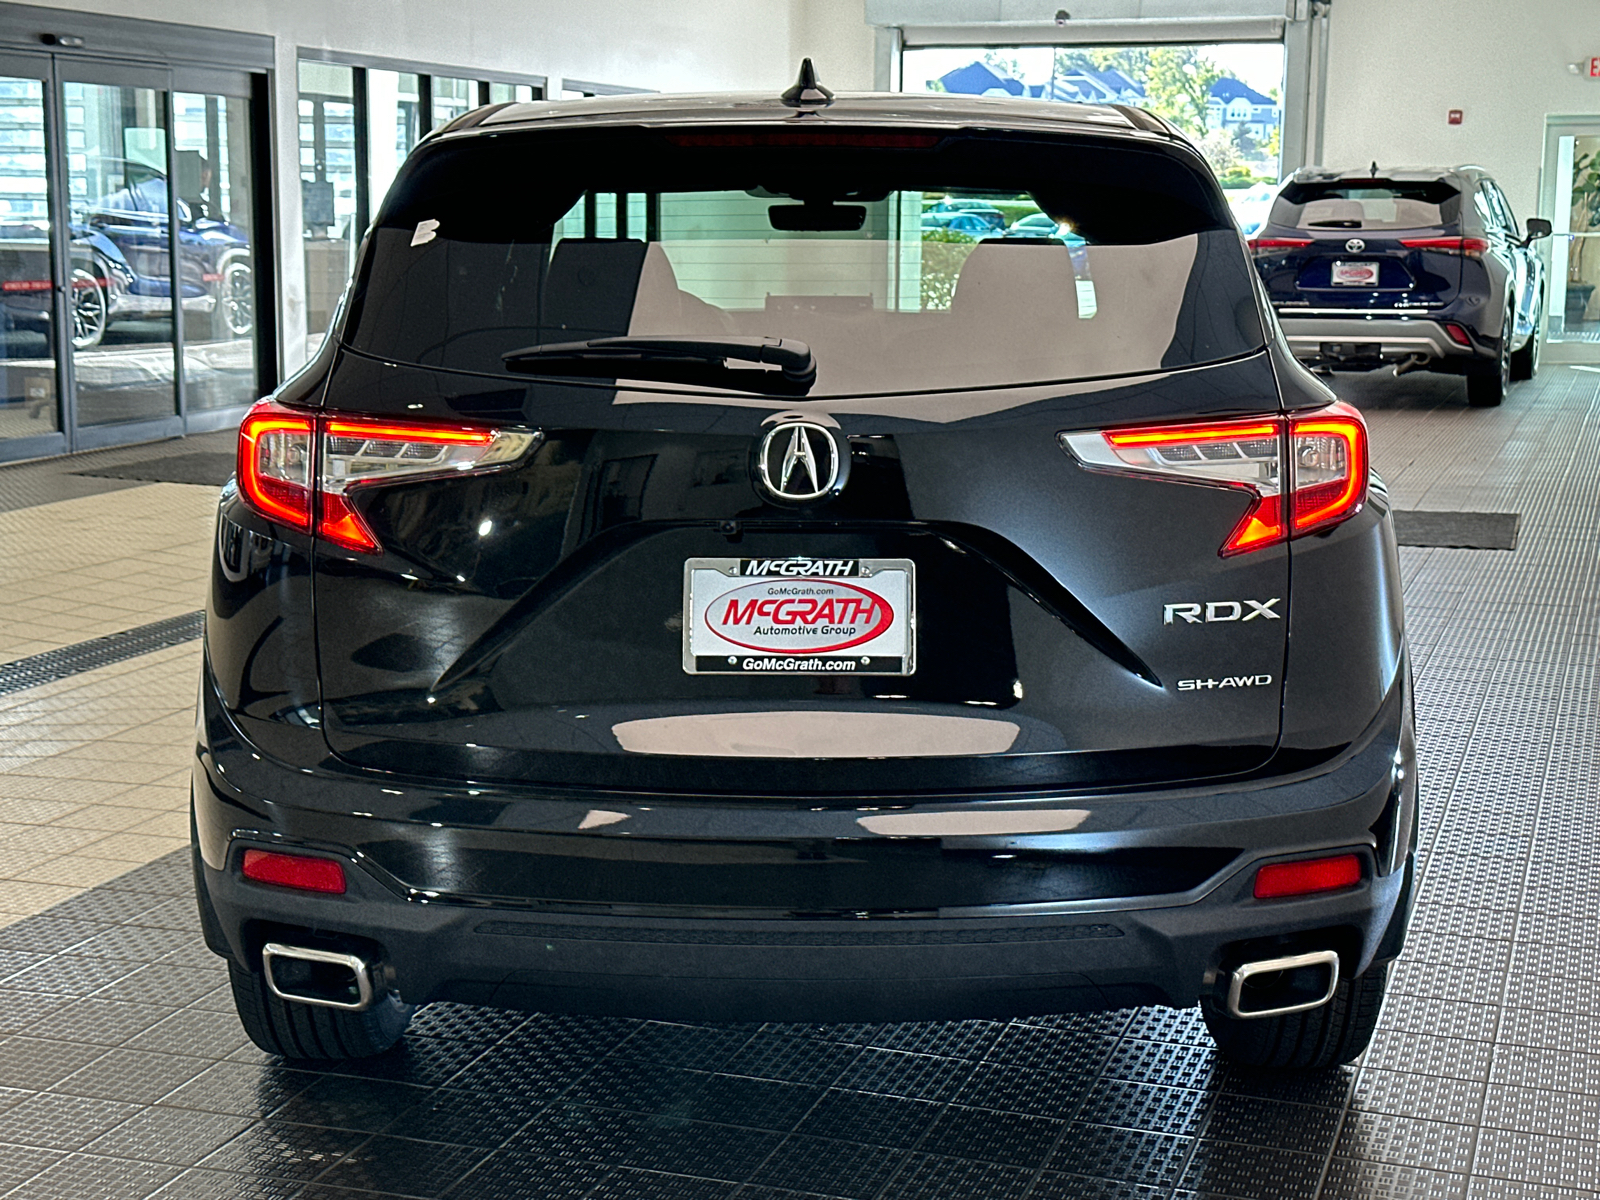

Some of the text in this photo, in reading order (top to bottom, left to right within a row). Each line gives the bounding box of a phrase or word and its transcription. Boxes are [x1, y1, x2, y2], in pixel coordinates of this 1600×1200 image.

[746, 560, 853, 576] McGRATH
[767, 588, 834, 596] GoMcGrath.com
[722, 598, 877, 625] McGRATH
[1163, 598, 1281, 625] RDX
[753, 625, 856, 637] Automotive Group
[743, 657, 855, 671] GoMcGrath.com
[1177, 674, 1272, 691] SH-AWD
